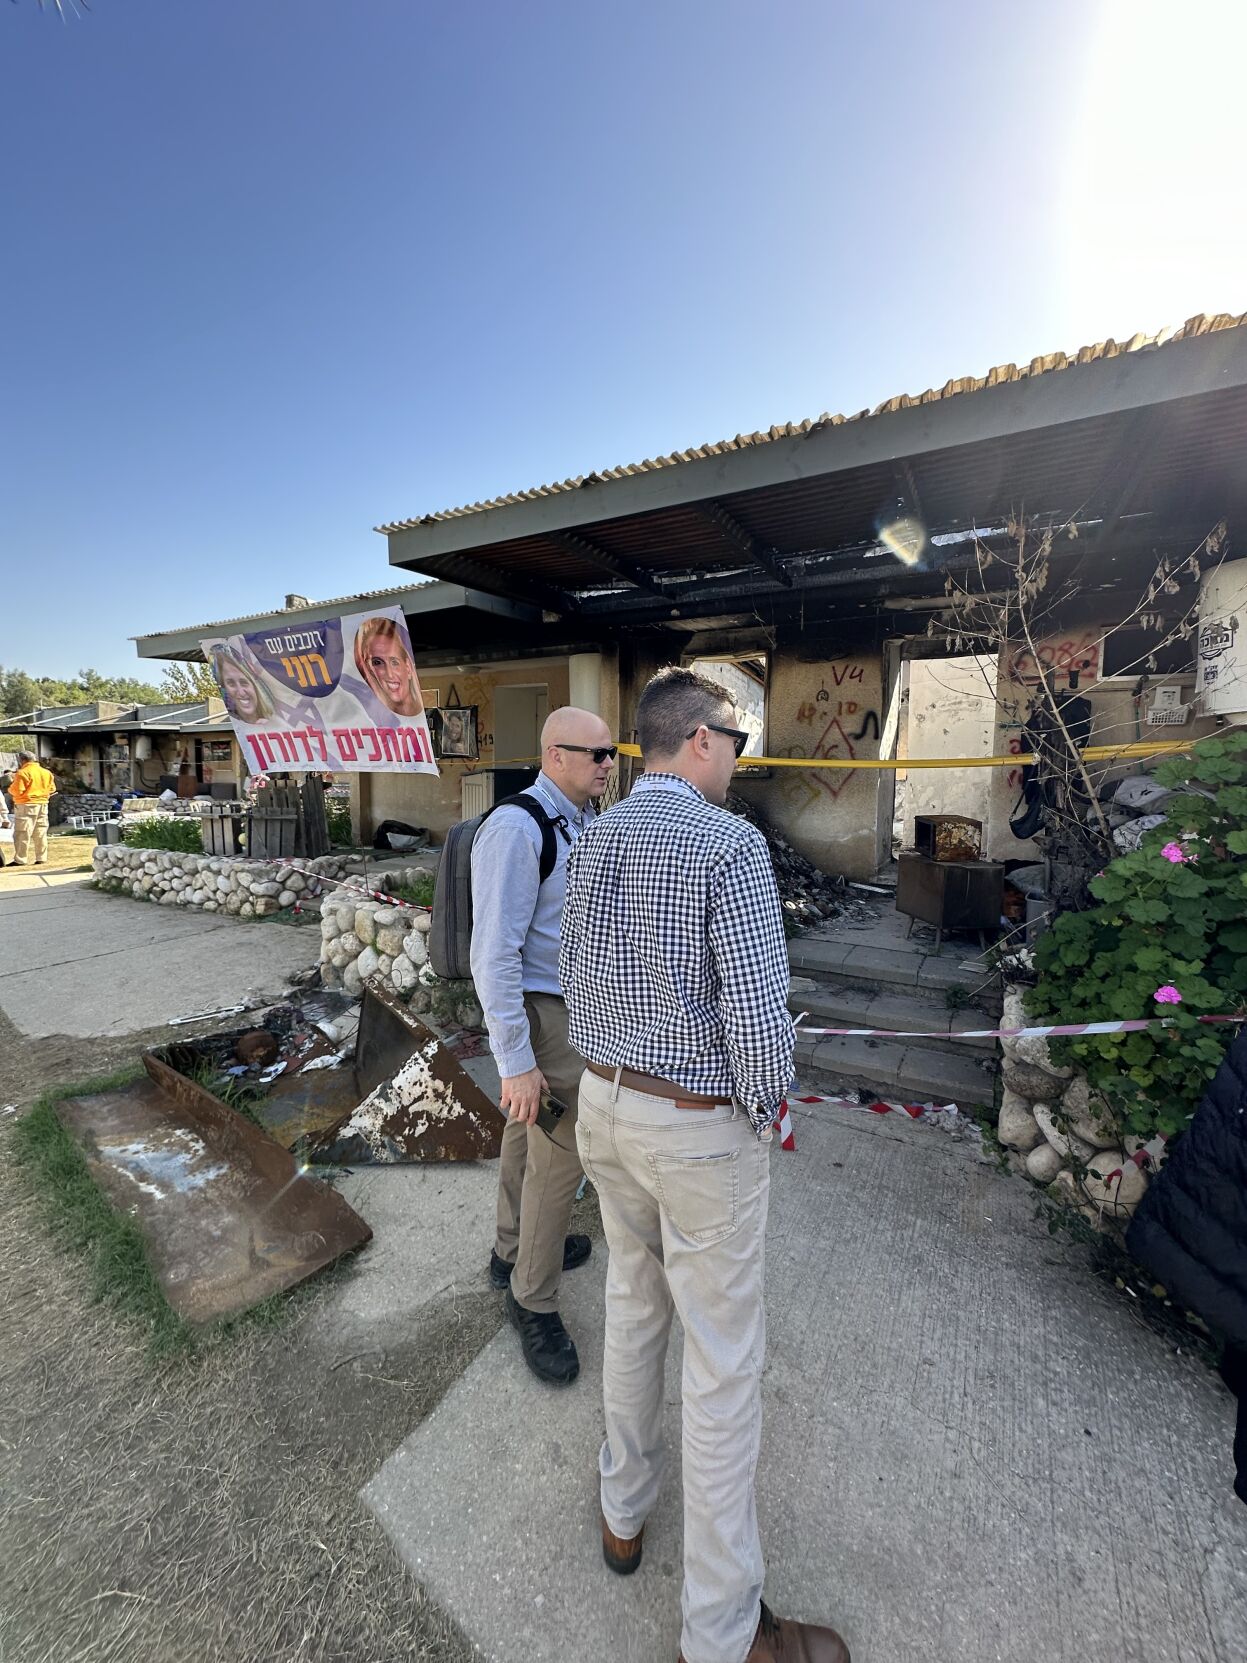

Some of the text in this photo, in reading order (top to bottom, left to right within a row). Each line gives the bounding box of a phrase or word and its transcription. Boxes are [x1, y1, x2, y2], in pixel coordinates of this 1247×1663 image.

[265, 631, 325, 654] רוכבים עם
[280, 653, 332, 687] רוני
[832, 664, 864, 686] V4
[246, 726, 327, 770] לדורון
[332, 726, 433, 763] ומחכים
